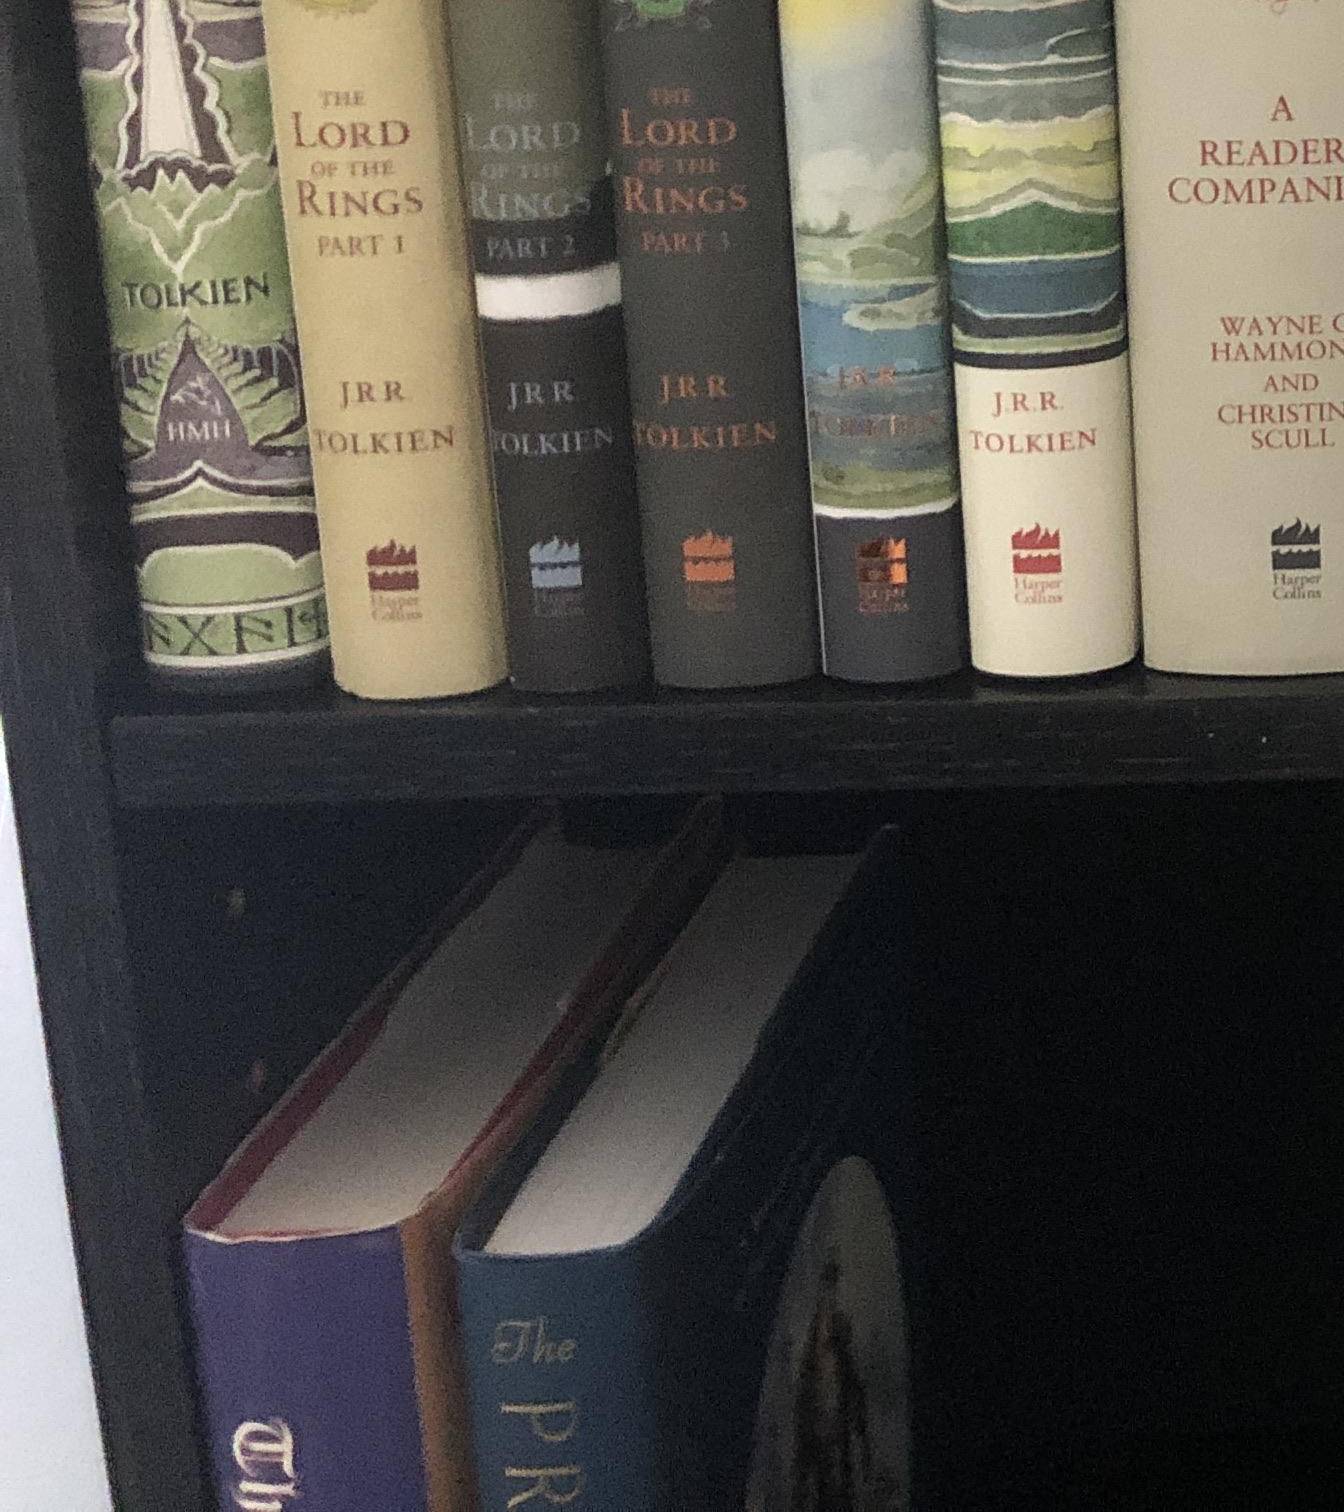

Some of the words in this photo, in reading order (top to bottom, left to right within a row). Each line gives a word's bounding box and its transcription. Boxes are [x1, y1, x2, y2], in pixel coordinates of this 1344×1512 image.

[320, 90, 365, 109] THE
[1269, 93, 1296, 122] A
[290, 110, 411, 149] LORD
[464, 113, 581, 151] LORD
[620, 107, 738, 146] LORD
[347, 158, 396, 177] THE
[296, 179, 424, 218] RINGS
[621, 175, 749, 215] RINGS
[317, 234, 384, 257] PART
[121, 272, 272, 311] TOLKIEN
[1219, 314, 1323, 337] WAYNE
[1263, 373, 1320, 393] AND
[167, 418, 230, 443] HMH
[315, 426, 454, 457] TOLKIEN
[634, 420, 776, 450] TOLKIEN
[969, 427, 1098, 455] TOLKIEN
[1250, 427, 1336, 450] SCULL
[491, 1314, 580, 1365] The
